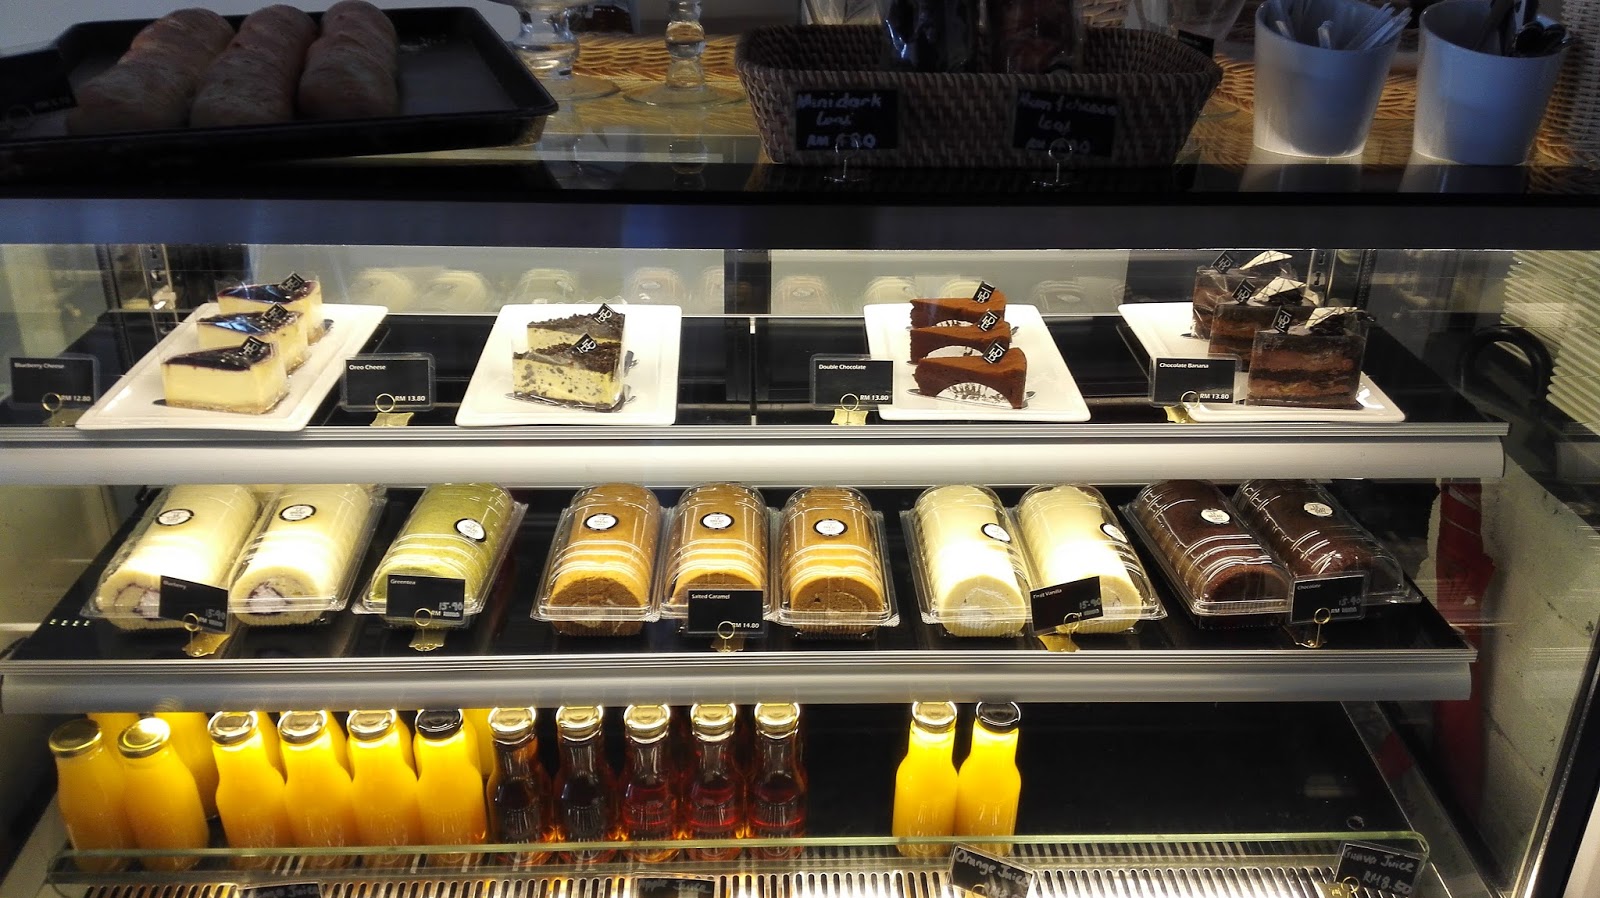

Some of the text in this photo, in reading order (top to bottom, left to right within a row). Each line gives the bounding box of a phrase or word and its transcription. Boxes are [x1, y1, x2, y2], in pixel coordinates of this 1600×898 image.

[818, 363, 867, 371] Double Chocolate
[1297, 583, 1322, 591] Chocolate
[1045, 588, 1063, 597] Vanilla
[438, 601, 464, 612] 15.90
[955, 850, 997, 876] Orange
[1380, 854, 1415, 873] Juice
